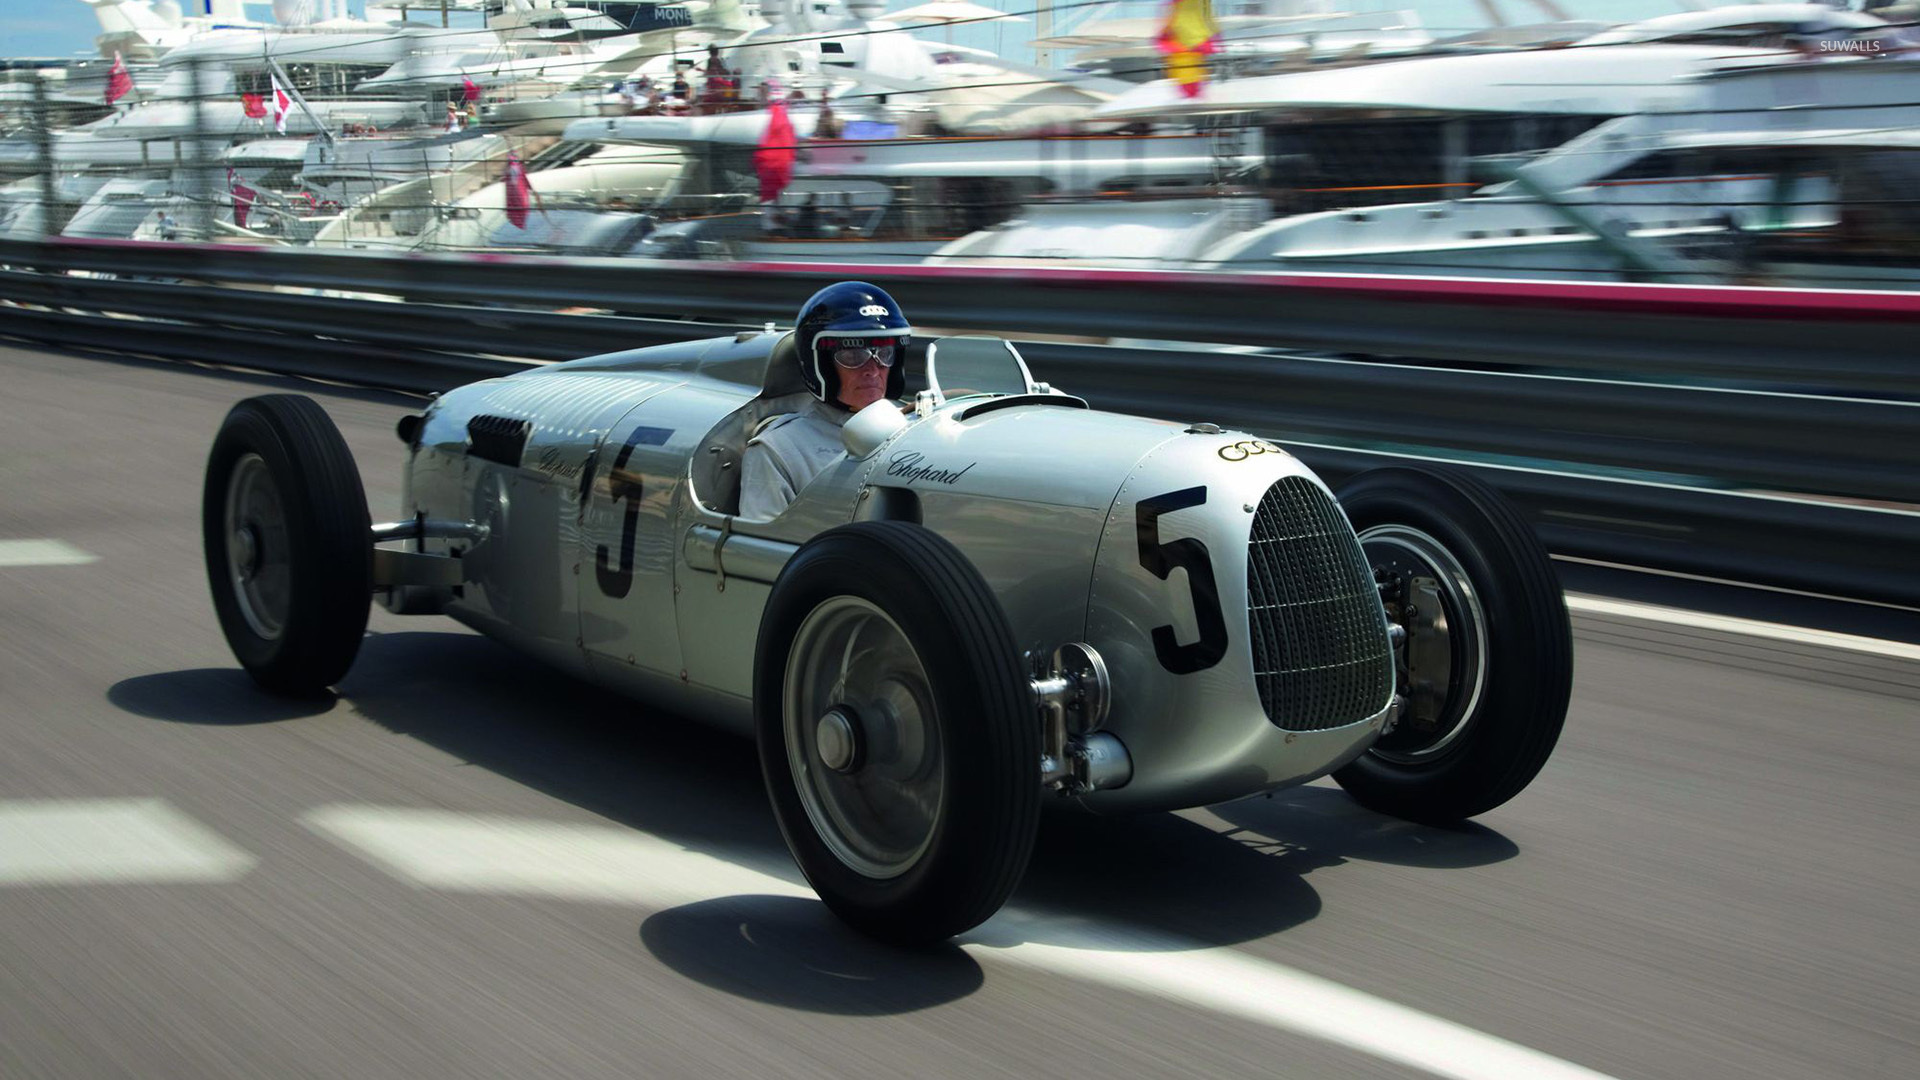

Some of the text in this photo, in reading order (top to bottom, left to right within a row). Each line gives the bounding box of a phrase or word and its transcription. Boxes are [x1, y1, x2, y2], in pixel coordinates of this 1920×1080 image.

[595, 425, 676, 599] 5
[887, 450, 977, 485] Chopard
[1135, 485, 1229, 676] 5
